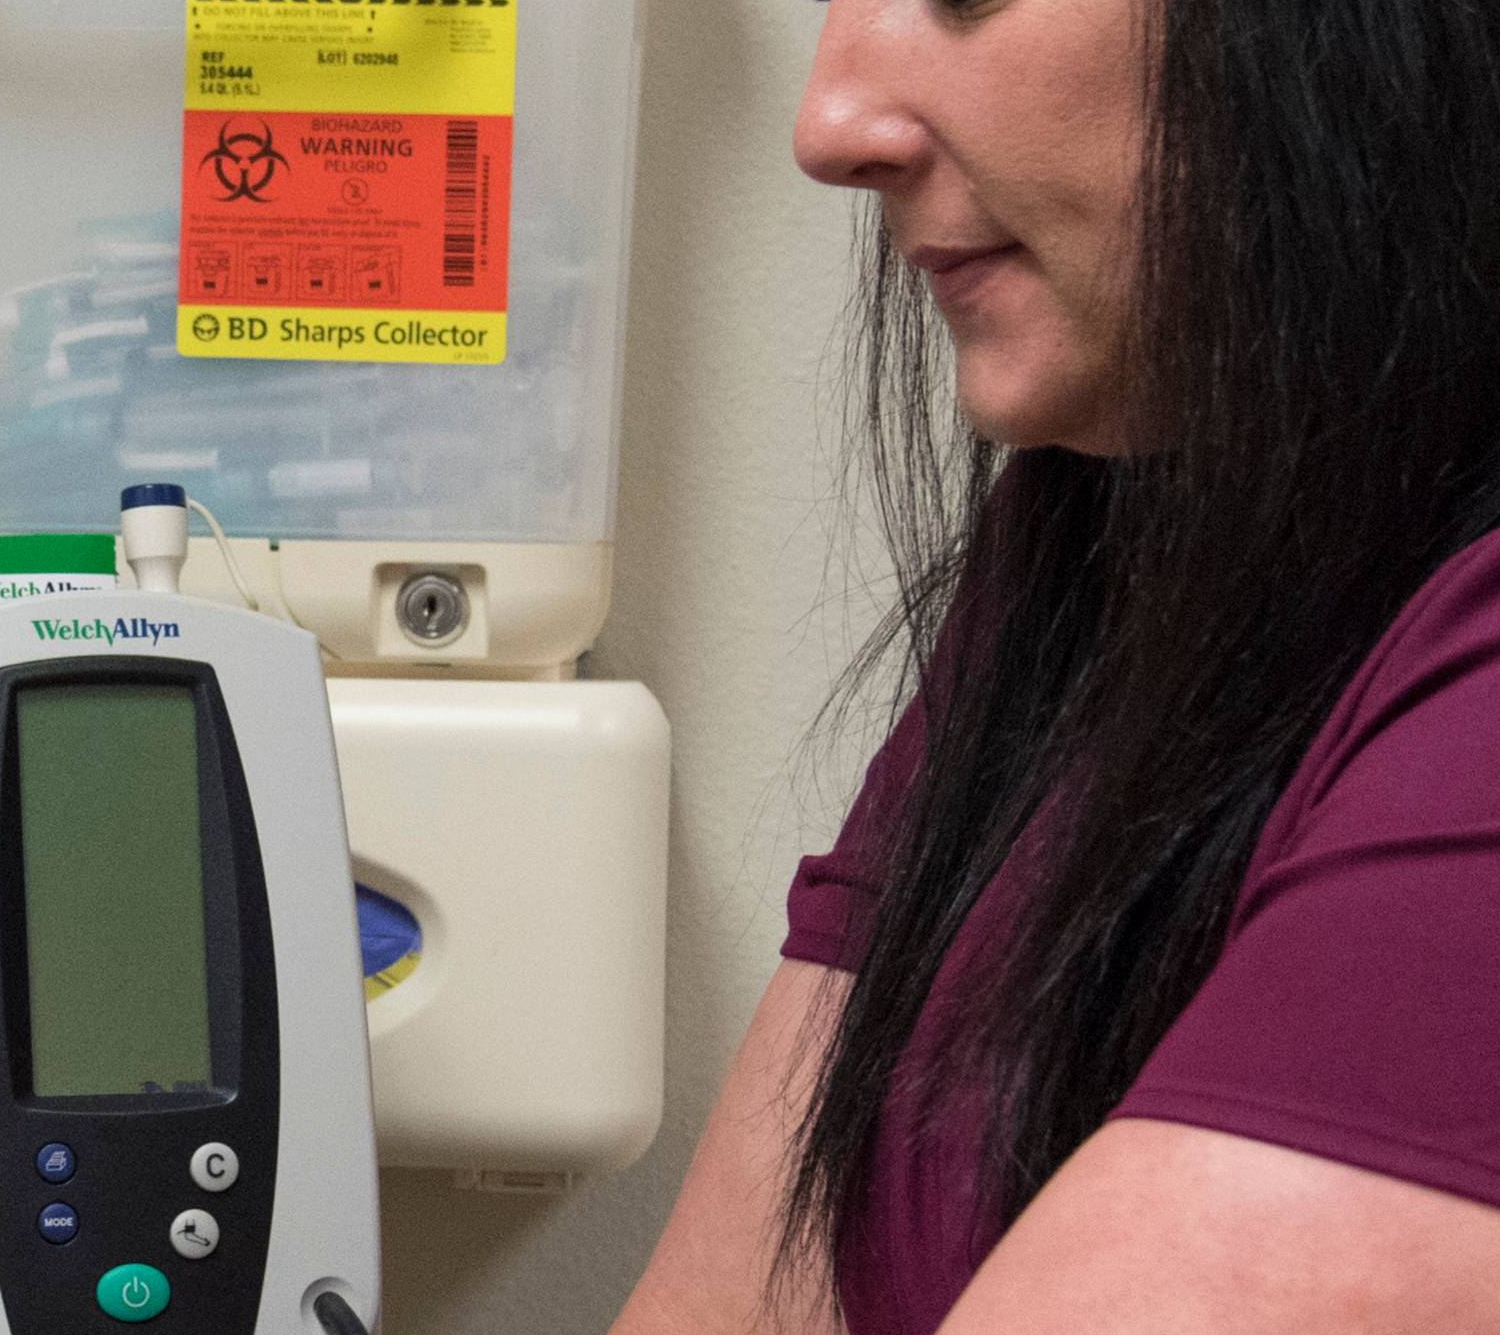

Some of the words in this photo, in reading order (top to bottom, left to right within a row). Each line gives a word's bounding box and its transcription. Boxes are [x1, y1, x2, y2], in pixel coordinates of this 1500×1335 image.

[224, 7, 246, 17] NOT
[250, 7, 270, 17] FILL
[275, 8, 311, 18] ABOVE
[315, 8, 338, 19] THIS
[201, 51, 224, 63] REF
[200, 66, 253, 79] 305444
[311, 118, 403, 133] BIOHAZARD
[299, 137, 413, 156] WARNING
[324, 158, 389, 173] PELIGRO
[228, 317, 268, 340] BD
[280, 318, 365, 348] Sharps
[374, 321, 488, 347] Collector
[205, 1152, 227, 1179] C
[43, 1216, 75, 1229] MODE
